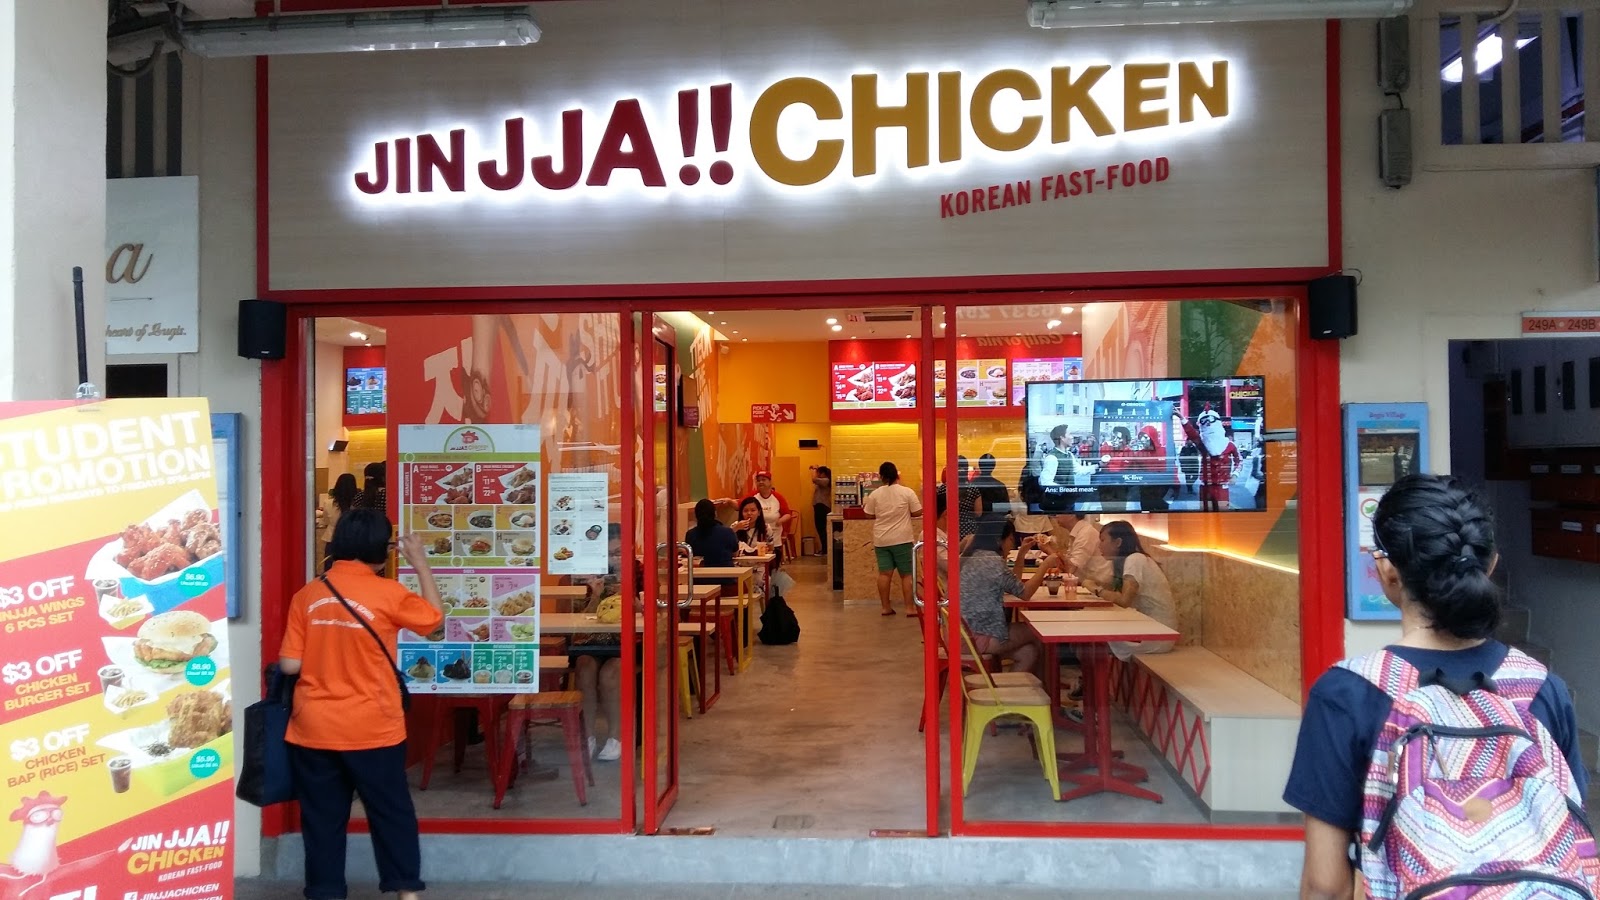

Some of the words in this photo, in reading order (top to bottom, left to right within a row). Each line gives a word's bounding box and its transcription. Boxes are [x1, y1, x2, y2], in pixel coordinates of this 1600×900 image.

[354, 129, 465, 195] JIN
[478, 82, 734, 190] JJA!!
[749, 60, 1229, 187] CHICKEN
[940, 180, 1031, 219] KOREAN
[1040, 157, 1169, 202] FAST-FOOD
[135, 324, 147, 341] of
[1528, 319, 1557, 331] 249A
[1567, 318, 1596, 330] 249B
[0, 445, 211, 499] ROMOTION
[413, 465, 419, 473] A
[476, 465, 482, 473] B
[106, 482, 121, 496] TO
[27, 575, 75, 598] OFF
[41, 596, 85, 614] WINGS
[5, 622, 15, 634] 6
[18, 617, 46, 632] PCS
[48, 611, 75, 625] SET
[2, 661, 32, 685] $3
[36, 649, 82, 673] OFF
[15, 672, 78, 695] CHICKEN
[4, 689, 63, 711] BURGER
[66, 682, 91, 698] SET
[10, 737, 39, 762] $3
[43, 723, 90, 750] OFF
[25, 746, 87, 770] CHICKEN
[7, 770, 36, 788] BAP
[39, 761, 78, 782] (RICE)
[82, 753, 107, 769] SET
[131, 832, 163, 850] JIN
[164, 820, 230, 849] JJA!!
[127, 845, 225, 875] CHICKEN
[158, 868, 186, 883] KOREAN
[186, 861, 223, 876] FAST-FOOD
[139, 883, 220, 900] JINJJACHICKEN
